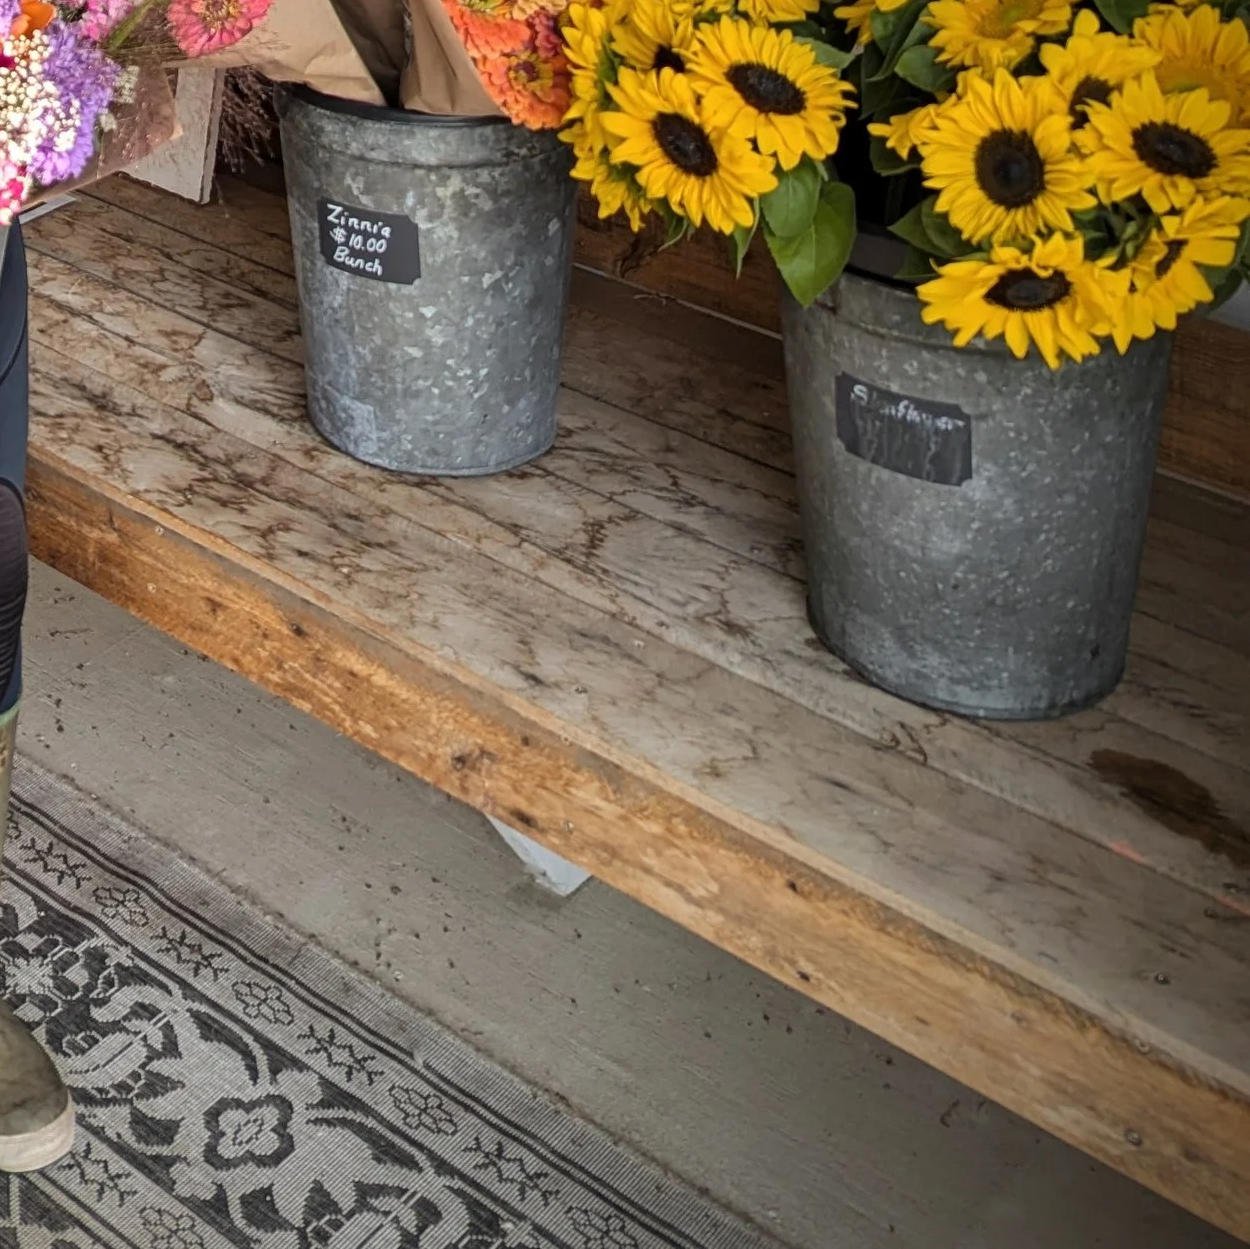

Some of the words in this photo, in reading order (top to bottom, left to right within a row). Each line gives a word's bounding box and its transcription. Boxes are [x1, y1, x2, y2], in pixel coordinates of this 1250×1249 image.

[327, 203, 391, 238] Zinnia
[330, 226, 387, 253] $10.00
[333, 246, 382, 276] Bunch
